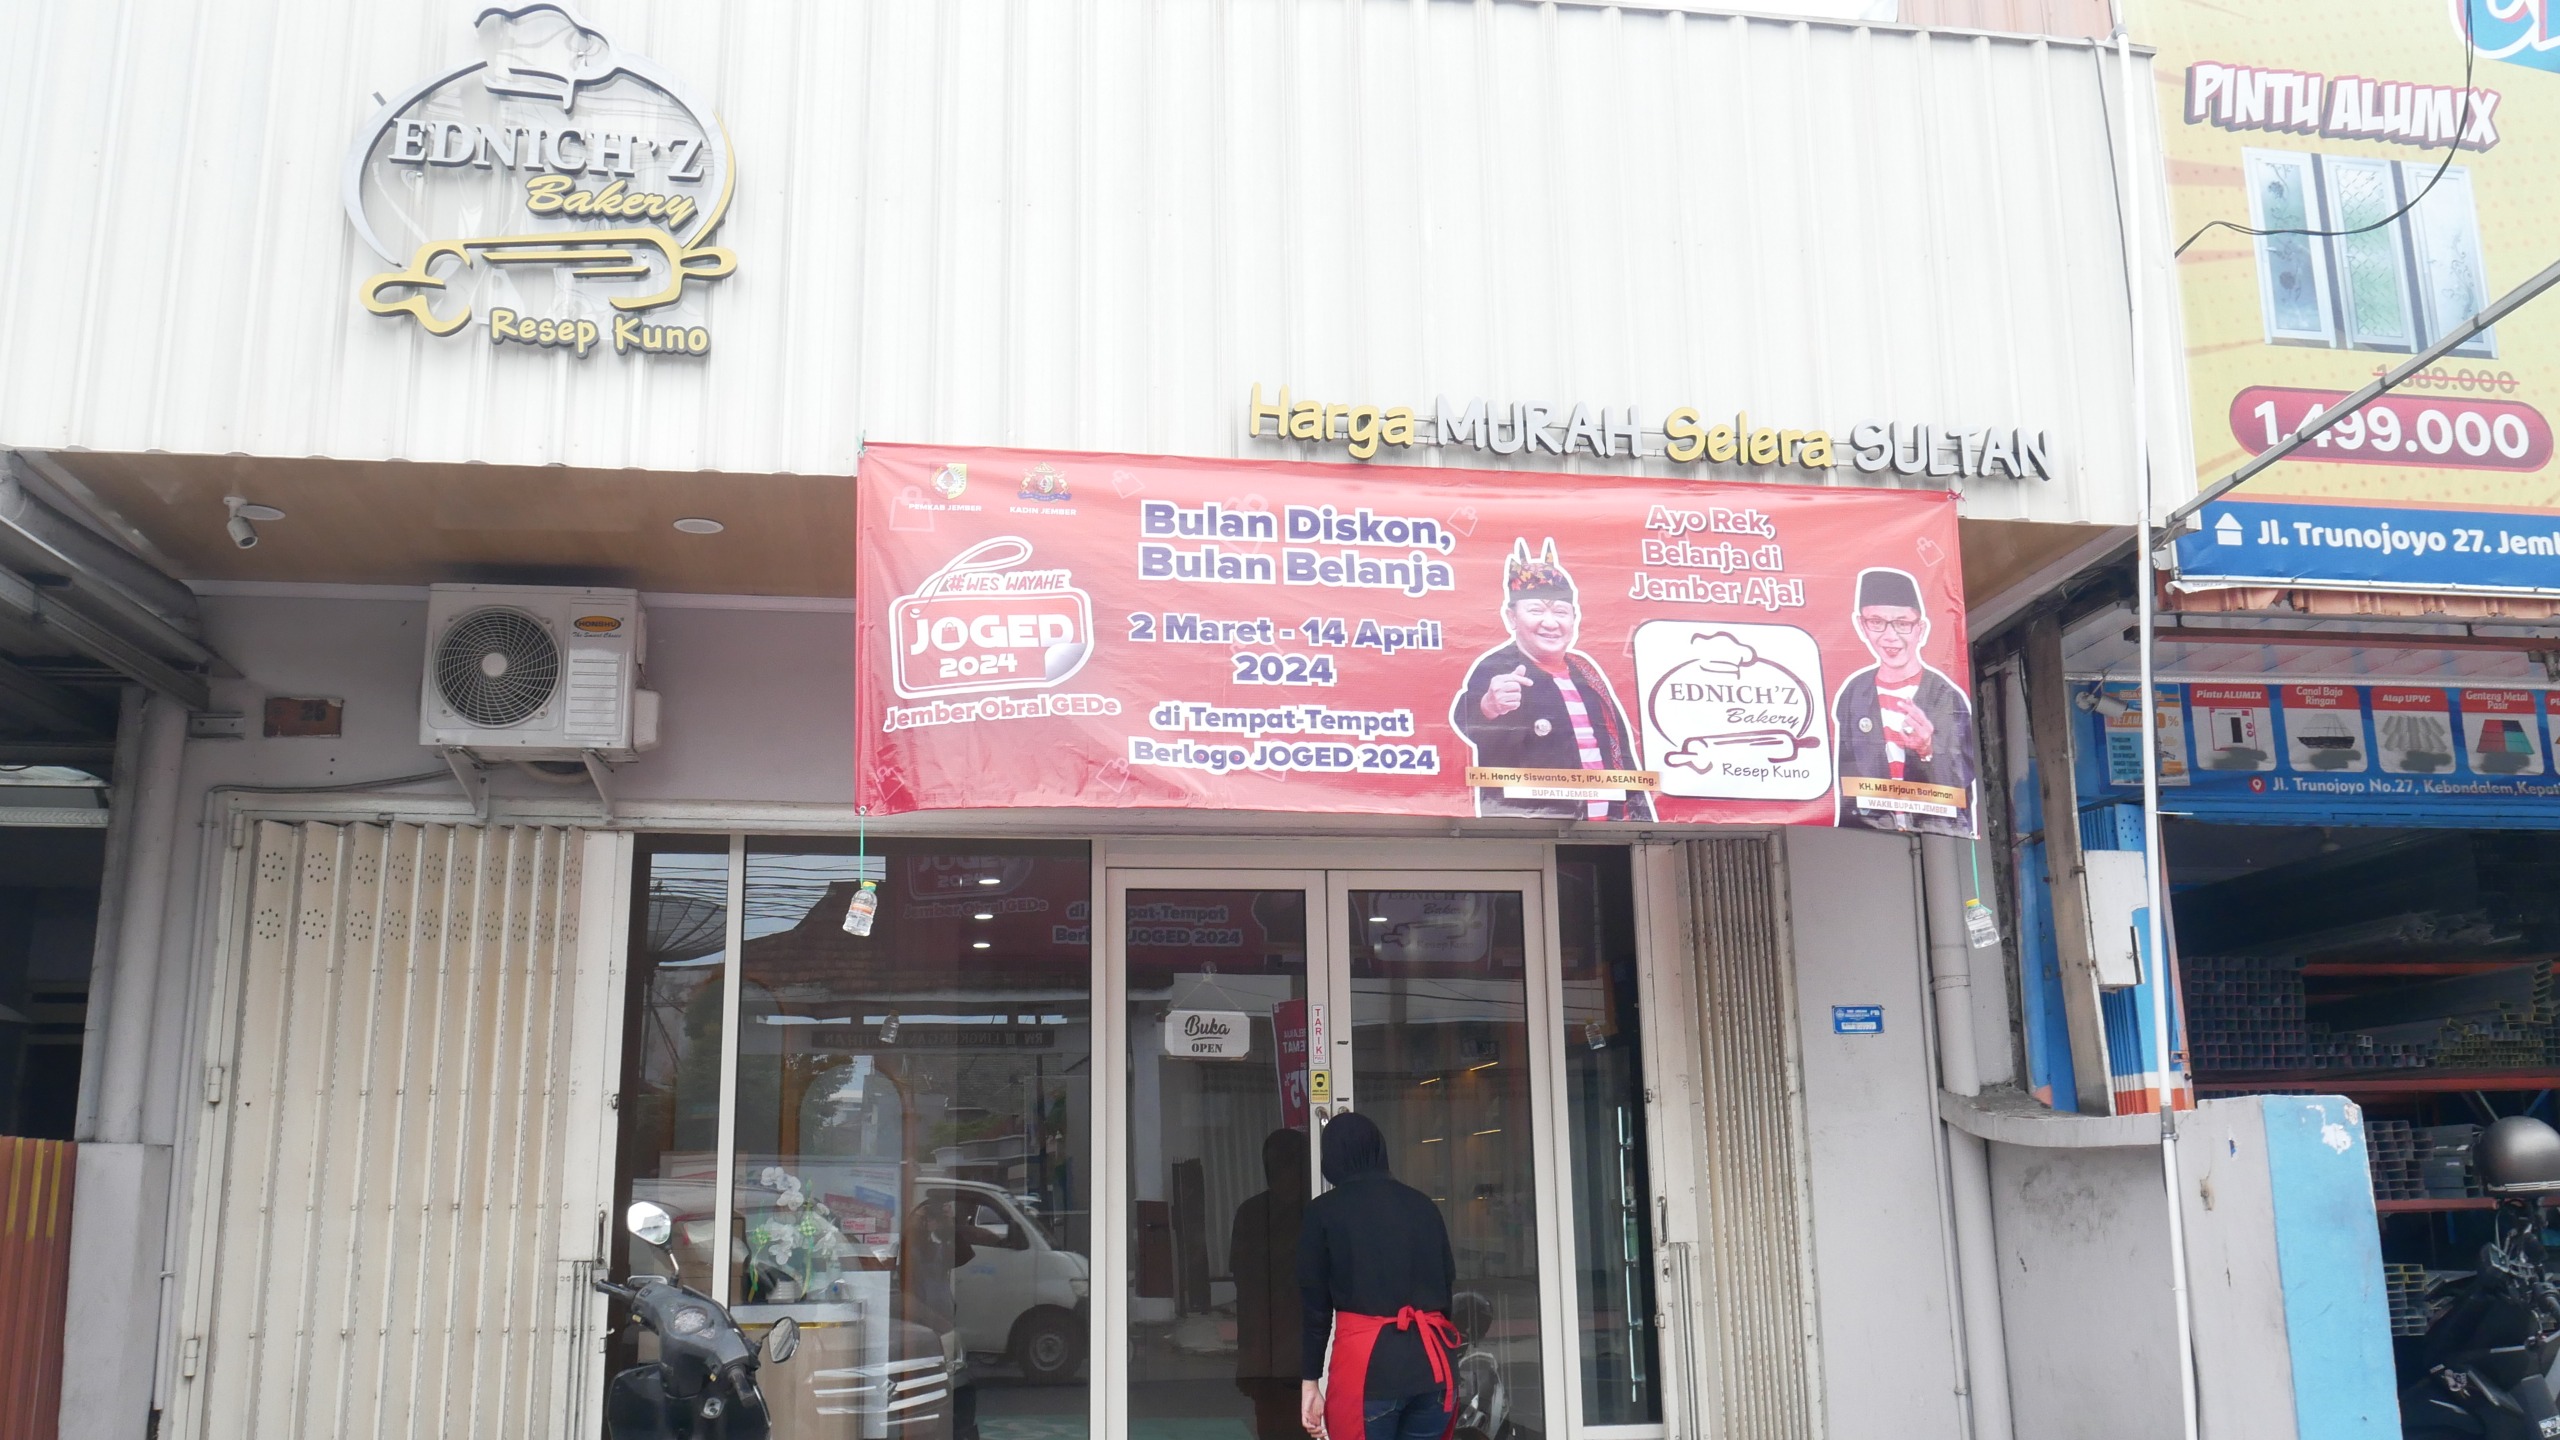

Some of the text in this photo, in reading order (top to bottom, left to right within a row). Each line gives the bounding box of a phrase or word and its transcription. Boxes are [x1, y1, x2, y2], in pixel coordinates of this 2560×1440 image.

[2191, 63, 2499, 147] PINTU ALUMIX
[388, 117, 705, 182] EDNICH'Z
[525, 174, 700, 230] Bakery
[489, 306, 711, 359] Resep Kuno
[1249, 382, 2053, 480] Harga MURAH Selera SULTAN
[908, 502, 982, 512] PEMKAB JEMBER
[1009, 505, 1077, 516] KADIN JEMBER
[1143, 502, 1454, 551] Bulan Diskon,
[1646, 506, 1774, 538] Ayo Rek,
[2258, 519, 2289, 545] Jl.
[2293, 521, 2446, 556] Trunojoyo
[1642, 540, 1782, 573] Belanja di
[1140, 545, 1452, 594] Bulan Belanja
[1006, 574, 1065, 591] WAYAHE
[1629, 573, 1804, 610] Jember Aja!
[1131, 613, 1154, 640] 2
[1165, 614, 1272, 643] Maret
[1303, 619, 1345, 646] 14
[1355, 621, 1440, 653] April
[939, 653, 1018, 678] 2024
[1236, 655, 1333, 683] 2024
[1669, 682, 1799, 705] EDNICH'Z
[2196, 689, 2262, 700] Pintu ALUMIX
[2305, 695, 2336, 707] Ringan
[2382, 694, 2431, 704] Atap UPVC
[2466, 691, 2528, 703] Genteng Metal
[2488, 700, 2509, 710] Pasir
[884, 696, 1119, 731] Jember Obral GEDe
[1155, 705, 1409, 736] di Tempat-Tempat
[1726, 708, 1799, 729] Bakery
[1134, 741, 1435, 770] Berlogo JOGED 2024
[1491, 773, 1521, 783] Hendy
[1524, 774, 1569, 783] Siswanto,
[1571, 775, 1584, 784] ST,
[1587, 775, 1603, 784] IPU,
[1606, 775, 1636, 784] ASEAN
[1638, 776, 1657, 786] Eng.
[1722, 763, 1810, 782] Resep Kuno
[1532, 789, 1599, 798] BUPATI JEMBER
[1859, 782, 1873, 791] KH.
[1889, 784, 1915, 795] Firjaun
[2273, 777, 2289, 791] Jl.
[2293, 778, 2365, 794] Trunojoyo
[1894, 801, 1920, 811] BUPATI
[1922, 804, 1948, 814] JEMBER
[1194, 930, 1242, 944] 2024
[1184, 1014, 1231, 1037] Buka
[1314, 1008, 1323, 1055] TARIK
[1191, 1043, 1223, 1053] OPEN
